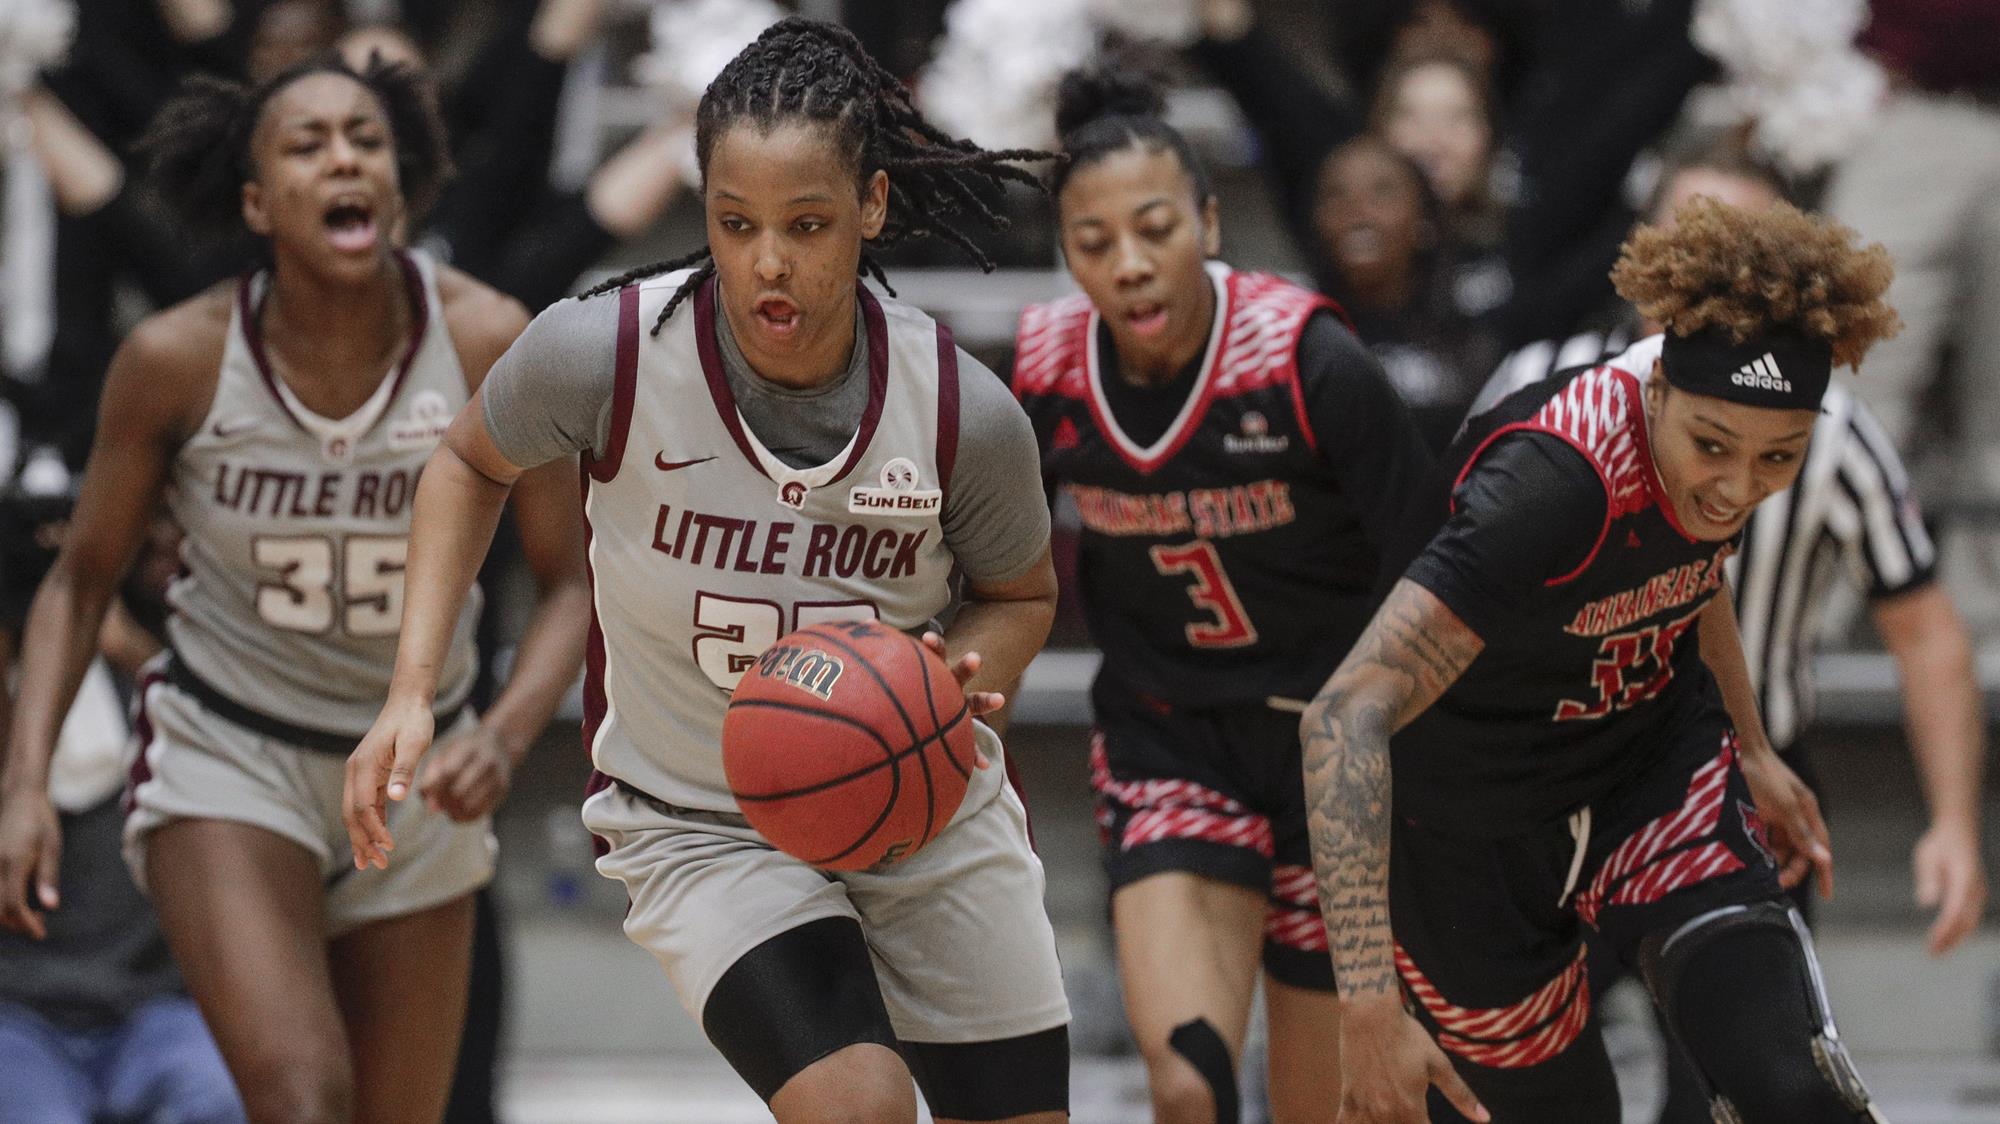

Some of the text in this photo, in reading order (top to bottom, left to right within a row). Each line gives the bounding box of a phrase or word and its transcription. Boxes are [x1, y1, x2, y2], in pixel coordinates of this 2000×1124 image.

[1730, 372, 1792, 393] adidas
[213, 463, 426, 519] LITTLE RO
[1188, 479, 1297, 539] STATE
[651, 503, 930, 579] LITTLE ROCK
[251, 531, 408, 638] 35
[1149, 539, 1259, 648] 3
[1563, 559, 1708, 636] ARKANSAS
[691, 590, 881, 693] 2
[757, 644, 845, 703] Wil
